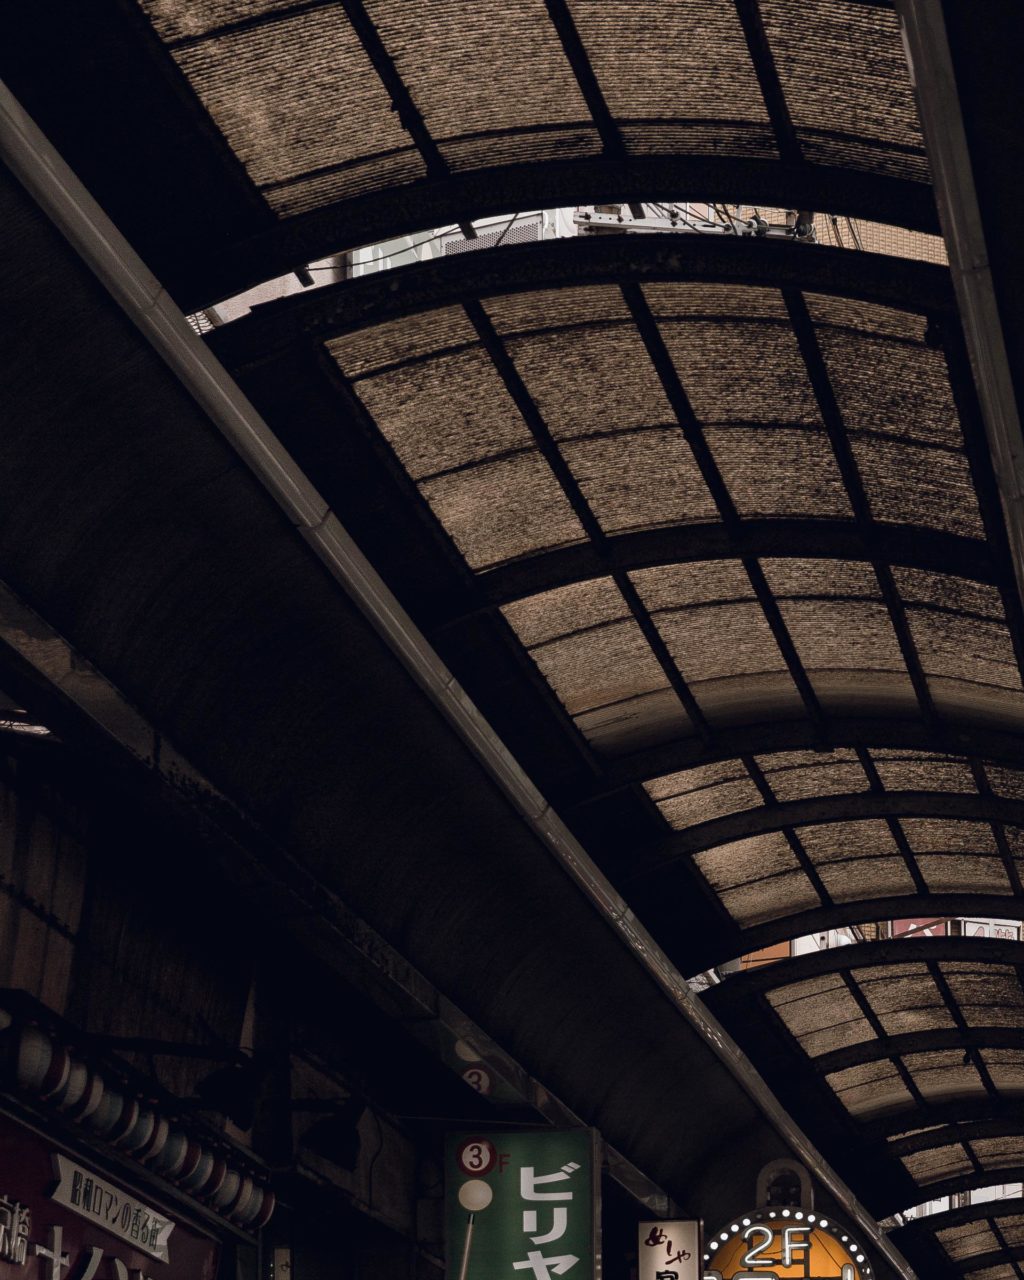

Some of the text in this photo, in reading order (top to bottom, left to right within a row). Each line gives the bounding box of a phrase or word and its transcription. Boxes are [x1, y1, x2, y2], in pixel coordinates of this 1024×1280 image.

[70, 1169, 160, 1251] 昭和ロマンの香る街
[644, 1226, 691, 1265] めしや
[742, 1224, 814, 1267] 2F
